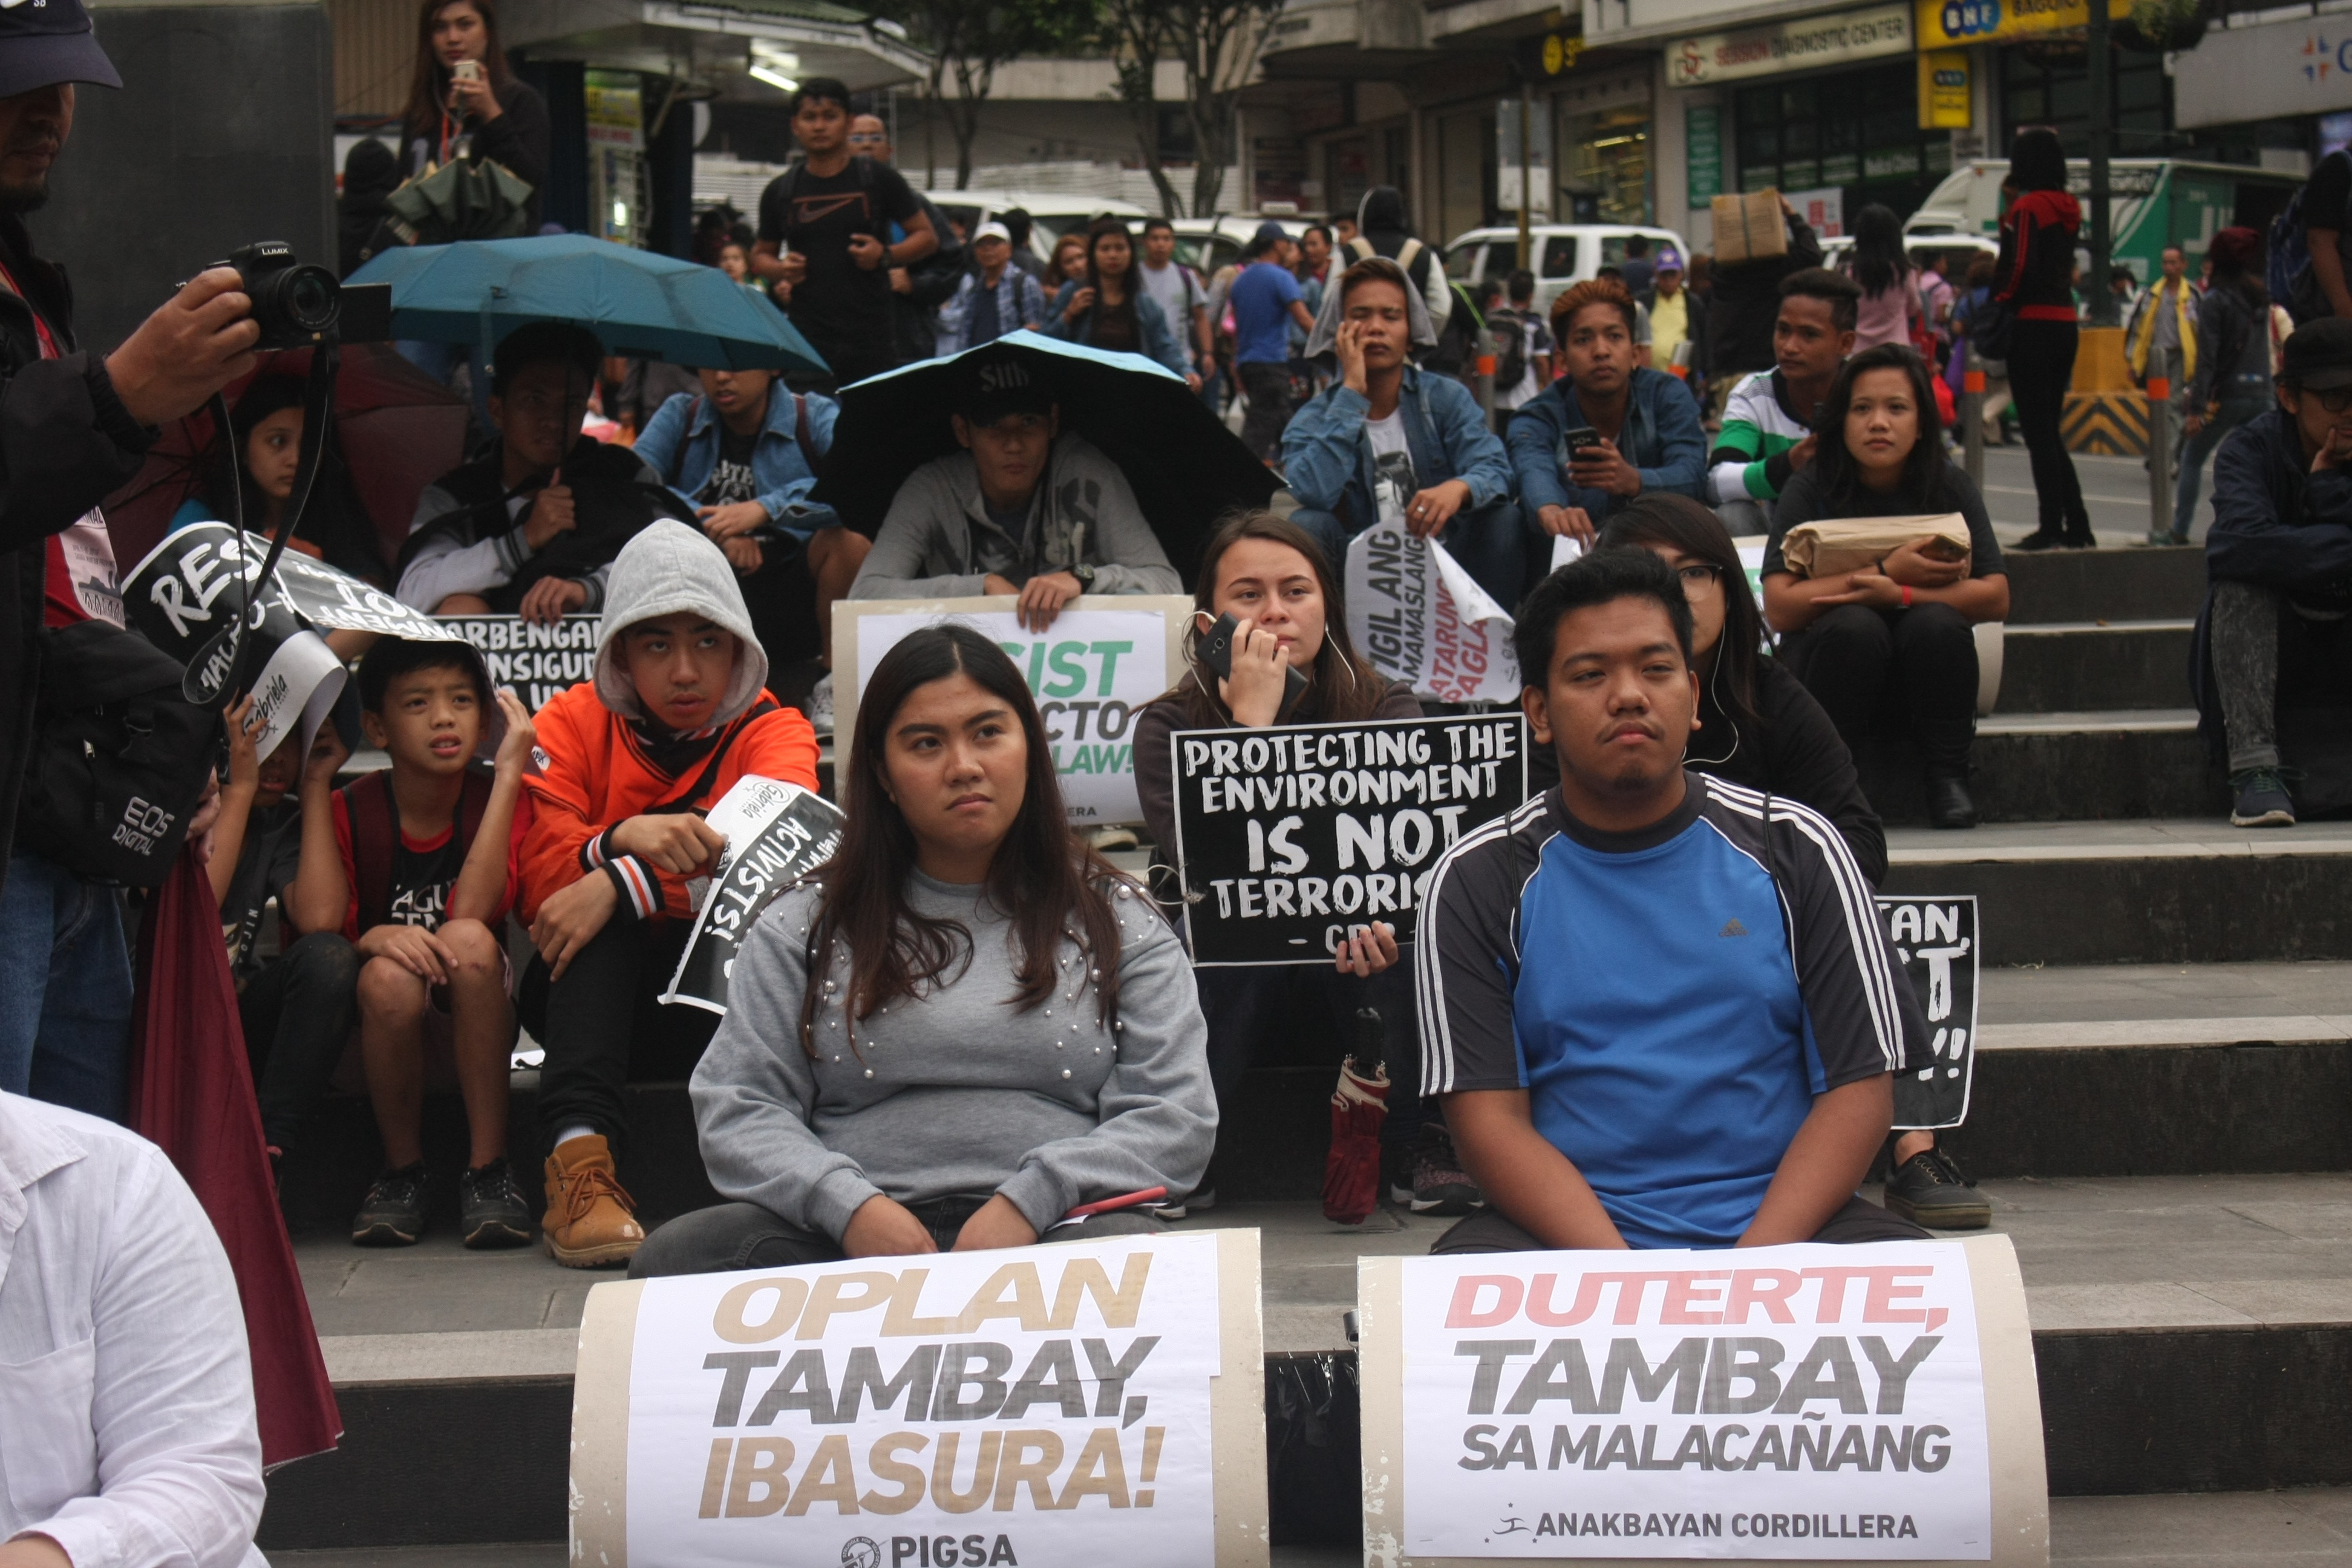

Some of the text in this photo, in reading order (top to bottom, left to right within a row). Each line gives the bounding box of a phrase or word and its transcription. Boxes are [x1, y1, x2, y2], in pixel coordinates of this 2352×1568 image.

[1367, 530, 1402, 670] IGIL ANG
[1184, 723, 1516, 777] PROTECTING THE
[124, 796, 175, 838] EOS
[1201, 760, 1502, 814] ENVIRONMENT
[112, 823, 154, 856] DIGITAL
[1247, 805, 1468, 875] IS NOT
[713, 1252, 1154, 1344] OPLAN
[1444, 1266, 1949, 1334] DUTERTE,
[702, 1336, 1162, 1431] TAMBAY,
[1453, 1335, 1944, 1416] TAMBAY
[699, 1426, 1165, 1518] IBASURA!
[1457, 1411, 1951, 1474] SA MALACAÑANG
[891, 1534, 1019, 1568] PIGSA
[1536, 1513, 1919, 1540] ANAKBAYAN CORDILLERA
